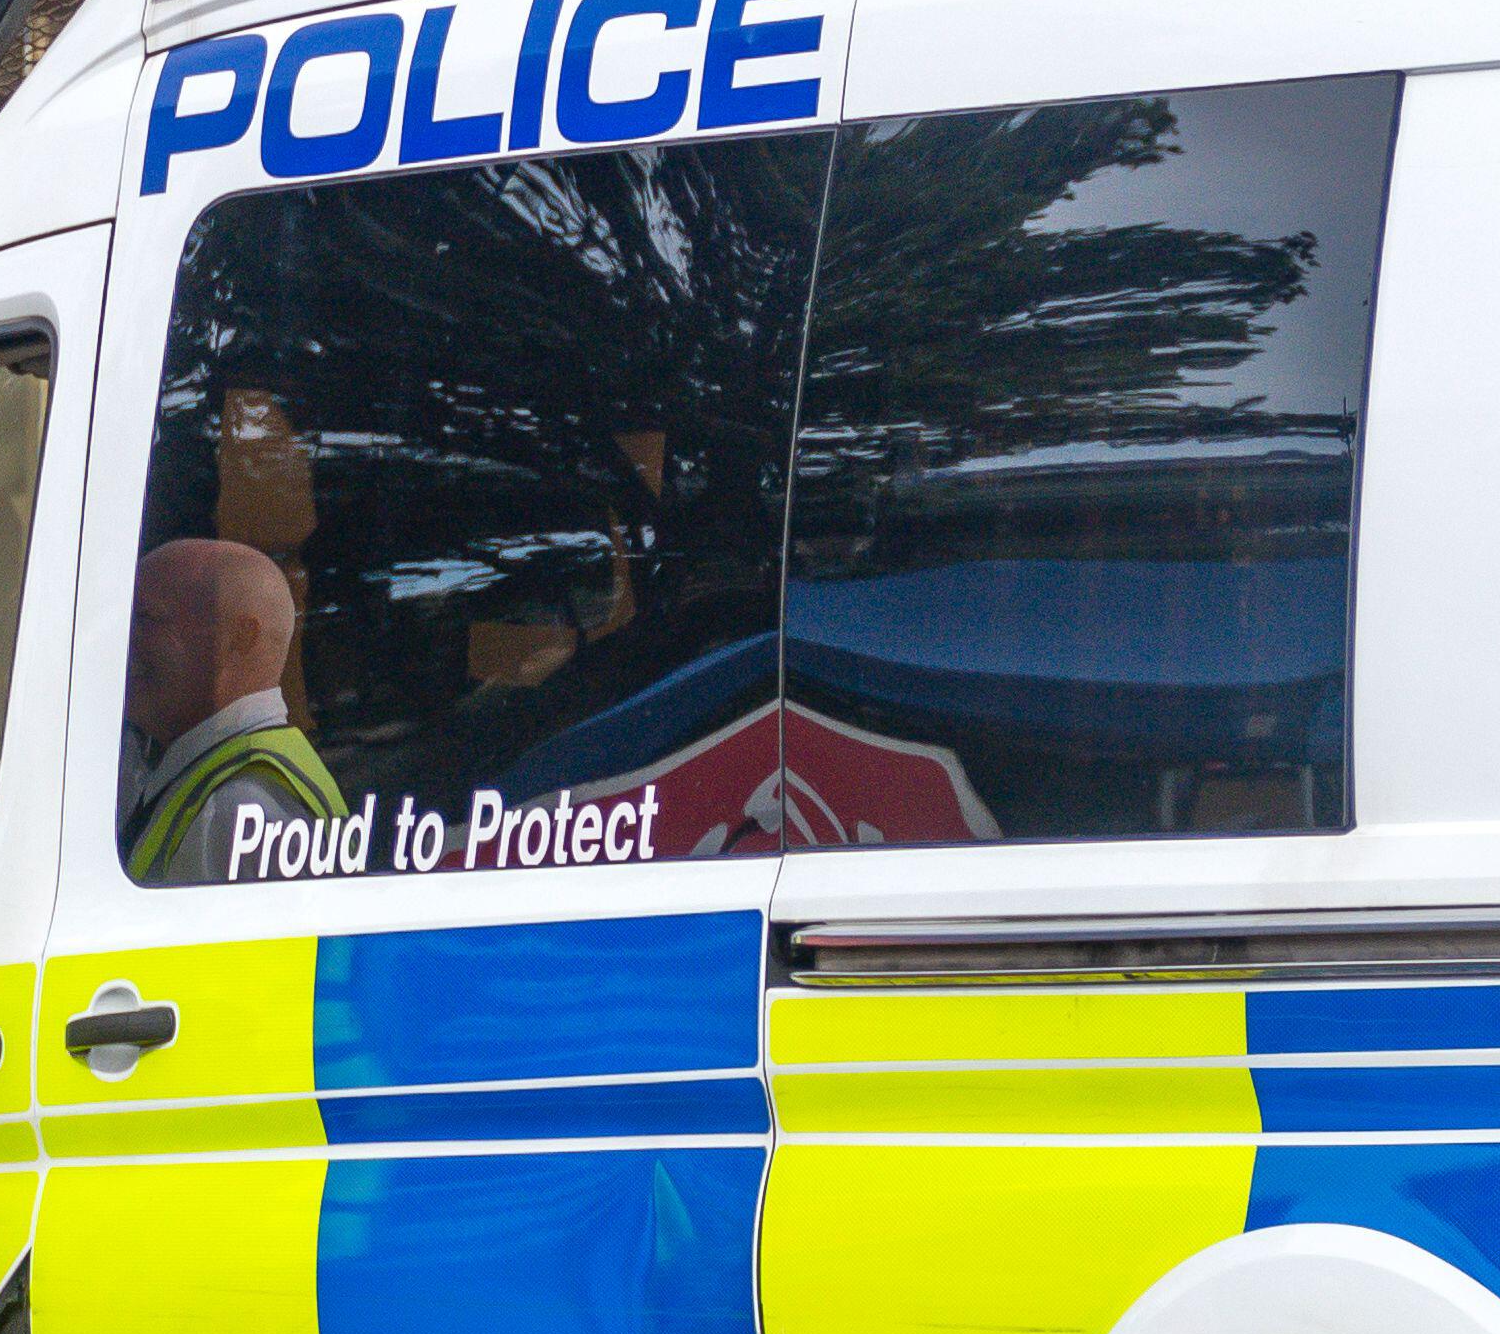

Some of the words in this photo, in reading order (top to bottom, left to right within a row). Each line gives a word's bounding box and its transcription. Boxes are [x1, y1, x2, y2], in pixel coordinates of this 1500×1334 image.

[228, 793, 376, 881] Proud
[393, 797, 445, 871] to
[464, 785, 660, 869] Protect
